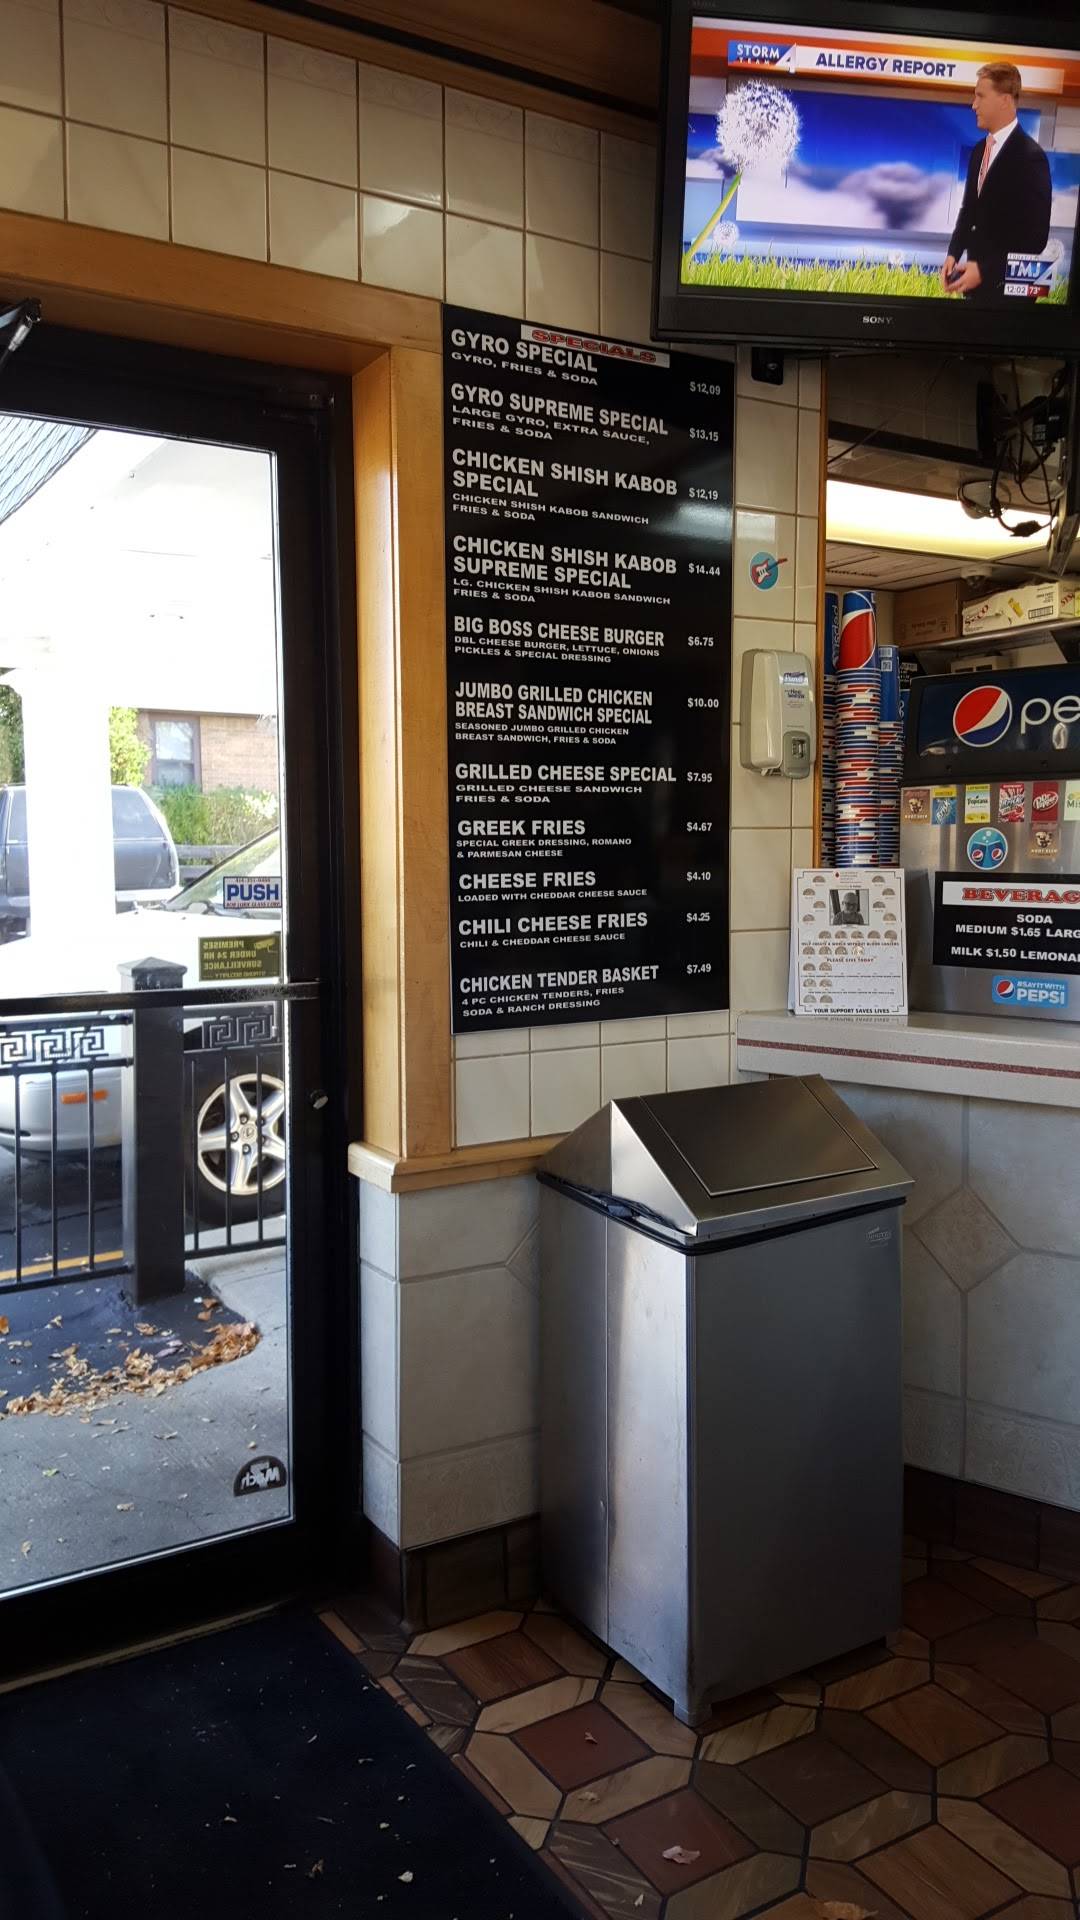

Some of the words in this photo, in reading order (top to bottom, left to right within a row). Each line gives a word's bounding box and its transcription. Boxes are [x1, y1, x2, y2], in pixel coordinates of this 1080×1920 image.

[736, 43, 780, 59] STORM
[739, 57, 770, 65] TEAM
[815, 52, 888, 71] ALLERGY
[892, 61, 956, 77] REPORT
[1006, 285, 1026, 294] 12:02
[862, 315, 893, 324] SONY
[450, 328, 509, 355] GYRO
[515, 340, 598, 373] SPECIAL
[531, 328, 657, 364] SPECIALS
[501, 360, 542, 376] FRIES
[547, 369, 556, 378] &
[561, 372, 598, 386] SODA
[689, 381, 721, 395] $12.09
[451, 383, 504, 407] GYRO
[509, 393, 594, 423] SUPREME
[599, 408, 668, 435] SPECIAL
[452, 405, 501, 420] LARGE
[553, 422, 599, 436] EXTRA
[452, 417, 495, 431] FRIES
[499, 424, 510, 432] &
[515, 427, 553, 440] SODA
[689, 428, 719, 442] $13.15
[452, 448, 544, 477] CHICKEN
[551, 462, 609, 486] SHISH
[614, 472, 678, 496] KABOB
[453, 470, 539, 497] SPECIAL
[689, 487, 718, 500] $12.19
[452, 493, 507, 507] CHICKEN
[510, 500, 546, 512] SHISH
[549, 505, 589, 517] KABOB
[591, 510, 649, 525] SANDWICH
[452, 504, 488, 515] FRIES
[504, 510, 536, 521] SODA
[453, 535, 545, 560] CHICKEN
[551, 546, 608, 568] SHISH
[614, 553, 677, 575] KABOB
[453, 556, 548, 582] SUPREME
[554, 567, 631, 589] SPECIAL
[688, 562, 721, 576] $14.44
[453, 588, 488, 599] FRIES
[491, 592, 500, 600] &
[504, 593, 536, 603] SODA
[476, 580, 530, 593] CHICKEN
[533, 585, 569, 596] SHISH
[572, 589, 611, 600] KABOB
[613, 593, 671, 605] SANDWICH
[454, 615, 484, 634] BIG
[488, 618, 533, 638] BOSS
[537, 623, 599, 643] CHEESE
[603, 627, 665, 646] BURGER
[454, 636, 476, 645] DBL
[478, 637, 521, 648] CHEESE
[622, 647, 660, 657] ONIONS
[687, 636, 714, 647] $6.75
[454, 646, 500, 656] PICKLES
[503, 649, 512, 657] &
[514, 650, 558, 660] SPECIAL
[561, 653, 612, 663] DRESSING
[455, 681, 513, 700] JUMBO
[517, 685, 583, 704] GRILLED
[587, 688, 653, 706] CHICKEN
[687, 697, 719, 708] $10.00
[455, 701, 514, 719] BREAST
[518, 704, 593, 722] SANDWICH
[597, 707, 652, 725] SPECIAL
[1020, 695, 1080, 735] pe
[455, 722, 508, 732] SEASONED
[510, 724, 545, 733] JUMBO
[547, 726, 586, 735] GRILLED
[588, 727, 629, 735] CHICKEN
[455, 733, 494, 742] BREAST
[553, 736, 580, 744] FRIES
[592, 737, 616, 745] SODA
[455, 763, 532, 780] GRILLED
[537, 764, 605, 781] CHEESE
[609, 767, 676, 782] SPECIAL
[686, 771, 713, 783] $7.95
[455, 784, 515, 793] GRILLED
[518, 784, 571, 793] CHEESE
[575, 785, 643, 793] SANDWICH
[455, 795, 496, 803] FRIES
[500, 795, 510, 803] &
[514, 795, 551, 803] SODA
[457, 820, 526, 836] GREEK
[531, 820, 586, 835] FRIES
[686, 821, 712, 833] $4.67
[456, 839, 499, 848] SPECIAL
[501, 839, 536, 848] GREEK
[592, 837, 632, 846] ROMANO
[456, 850, 464, 858] &
[467, 850, 523, 858] PARMESAN
[458, 873, 537, 890] CHEESE
[543, 871, 596, 887] FRIES
[686, 871, 711, 881] $4.10
[226, 884, 279, 900] PUSH
[457, 893, 499, 902] LOADED
[501, 892, 527, 900] WITH
[529, 891, 576, 900] CHEDDAR
[577, 889, 615, 898] CHEESE
[617, 888, 648, 897] SAUCE
[458, 917, 511, 935] CHILI
[517, 915, 591, 933] CHEESE
[597, 912, 648, 929] FRIES
[686, 911, 710, 922] $4.25
[1016, 914, 1053, 924] SODA
[955, 924, 1007, 935] MEDIUM
[1011, 926, 1041, 937] $1.65
[459, 939, 488, 949] CHILI
[491, 939, 499, 947] &
[502, 937, 550, 946] CHEDDAR
[552, 934, 591, 943] CHEESE
[593, 932, 626, 941] SAUCE
[951, 946, 982, 957] MILK
[986, 948, 1017, 958] $1.50
[1020, 950, 1080, 963] LEMONA
[686, 963, 711, 975] $7.49
[459, 974, 533, 994] CHICKEN
[536, 969, 598, 988] TENDER
[602, 964, 659, 983] BASKET
[1017, 980, 1065, 990] #SAYITWITH
[461, 998, 469, 1006] 4
[471, 996, 487, 1005] PC
[489, 993, 539, 1004] CHICKEN
[595, 987, 625, 996] FRIES
[1016, 988, 1065, 1004] PEPSI
[462, 1007, 493, 1017] SODA
[496, 1006, 504, 1014] &
[507, 1003, 545, 1013] RANCH
[548, 999, 600, 1010] DRESSING
